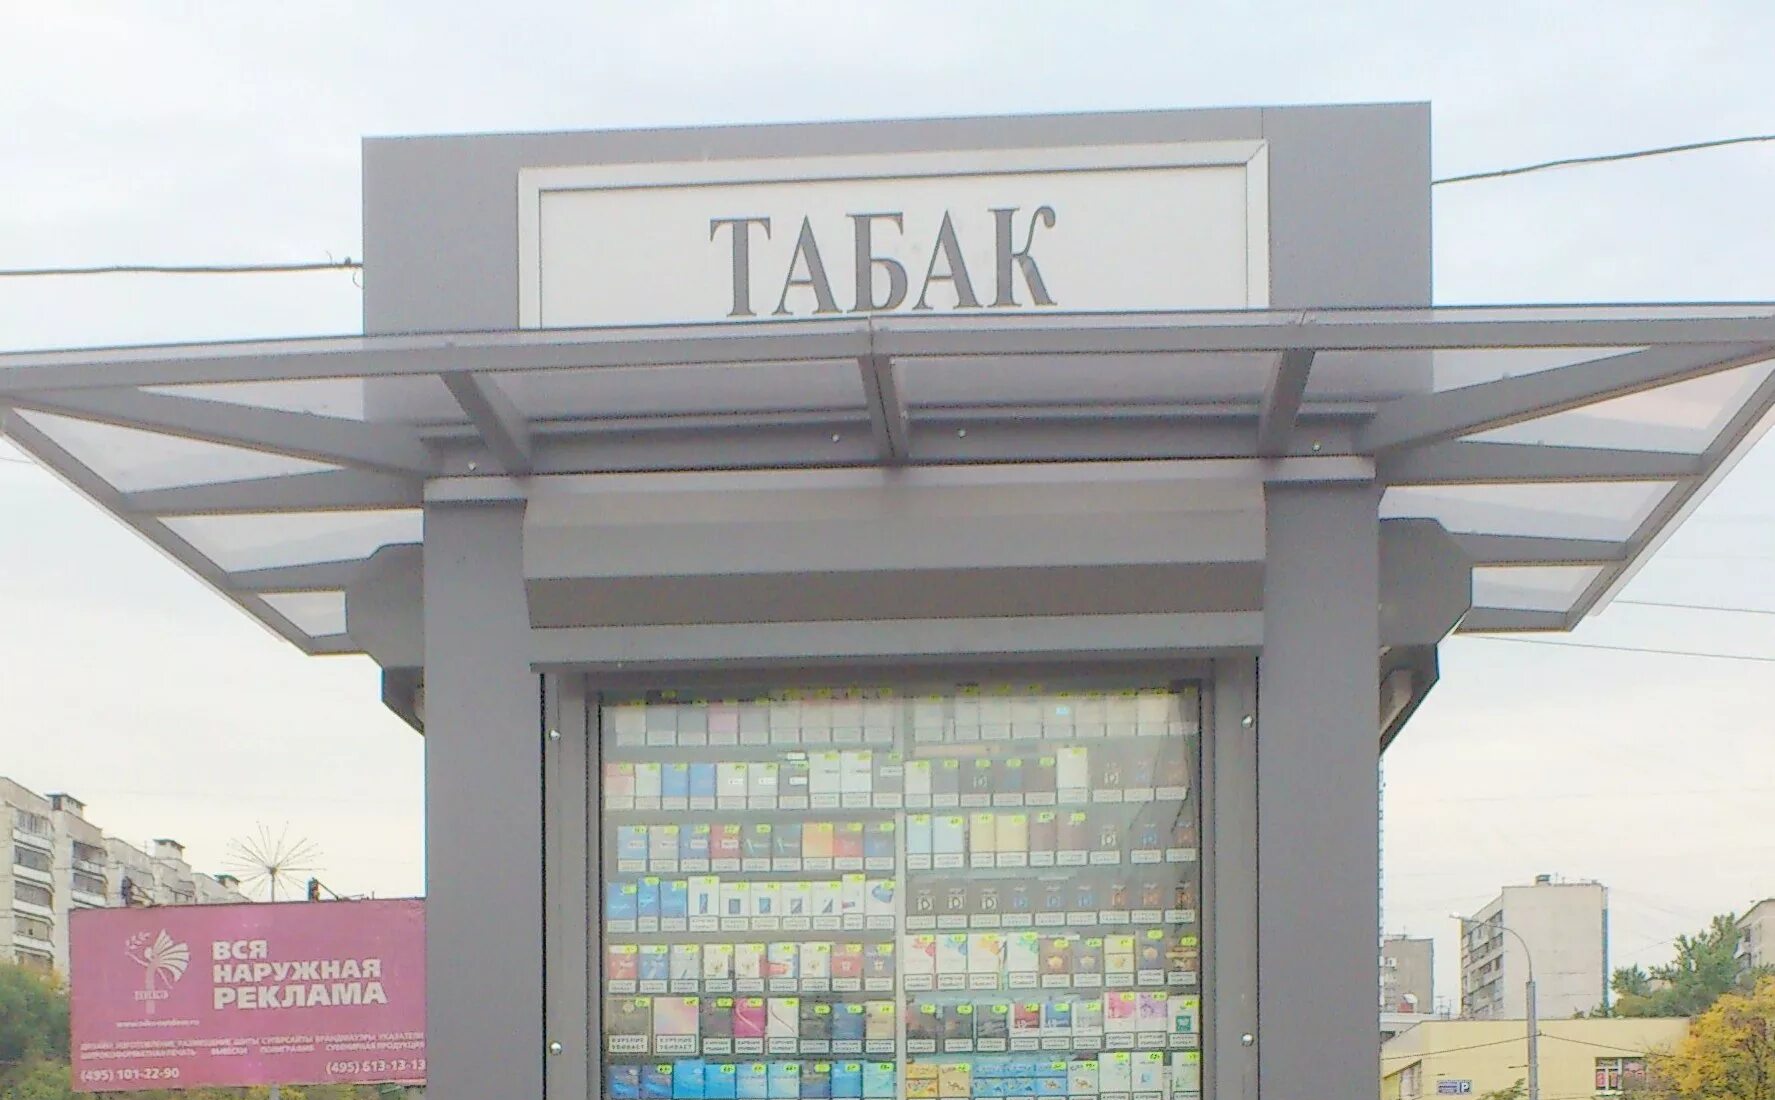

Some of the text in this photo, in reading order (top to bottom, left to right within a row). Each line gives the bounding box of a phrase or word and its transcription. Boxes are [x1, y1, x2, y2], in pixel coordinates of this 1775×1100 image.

[709, 205, 1058, 318] ТАБАК
[211, 939, 269, 961] ВСЯ
[212, 958, 383, 983] НАРУЖНАЯ
[212, 981, 389, 1010] РЕКЛАМА
[80, 1068, 114, 1083] (495)
[326, 1061, 360, 1075] (495)
